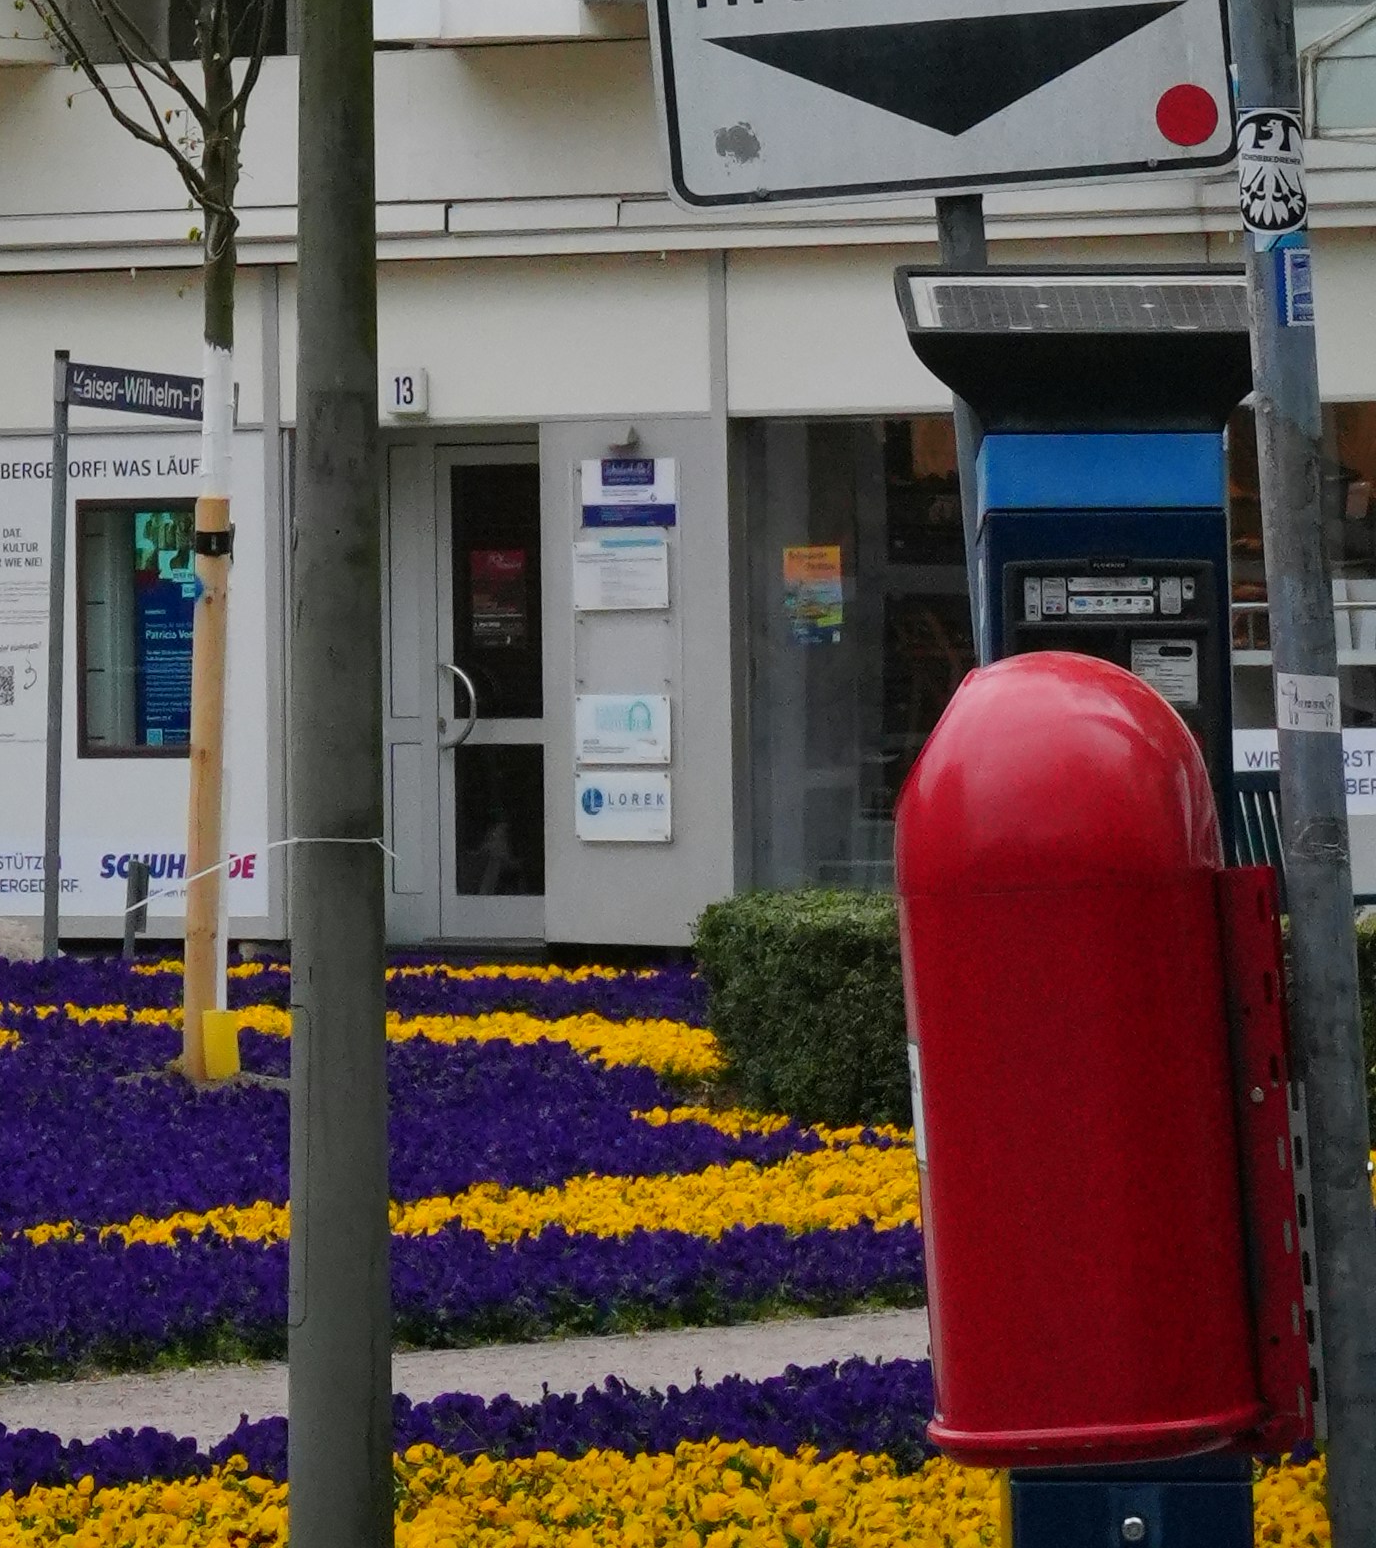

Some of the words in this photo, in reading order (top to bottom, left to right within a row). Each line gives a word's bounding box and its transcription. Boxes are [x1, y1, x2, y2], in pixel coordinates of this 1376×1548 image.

[73, 370, 204, 413] Kaiser-Wilhelm-P
[394, 376, 414, 405] 13
[0, 459, 108, 480] BERGEORF!
[112, 458, 152, 479] WAS
[156, 453, 201, 477] LÄUF
[3, 542, 39, 553] KULTUR
[4, 557, 22, 568] WIE
[608, 793, 665, 806] LOREK
